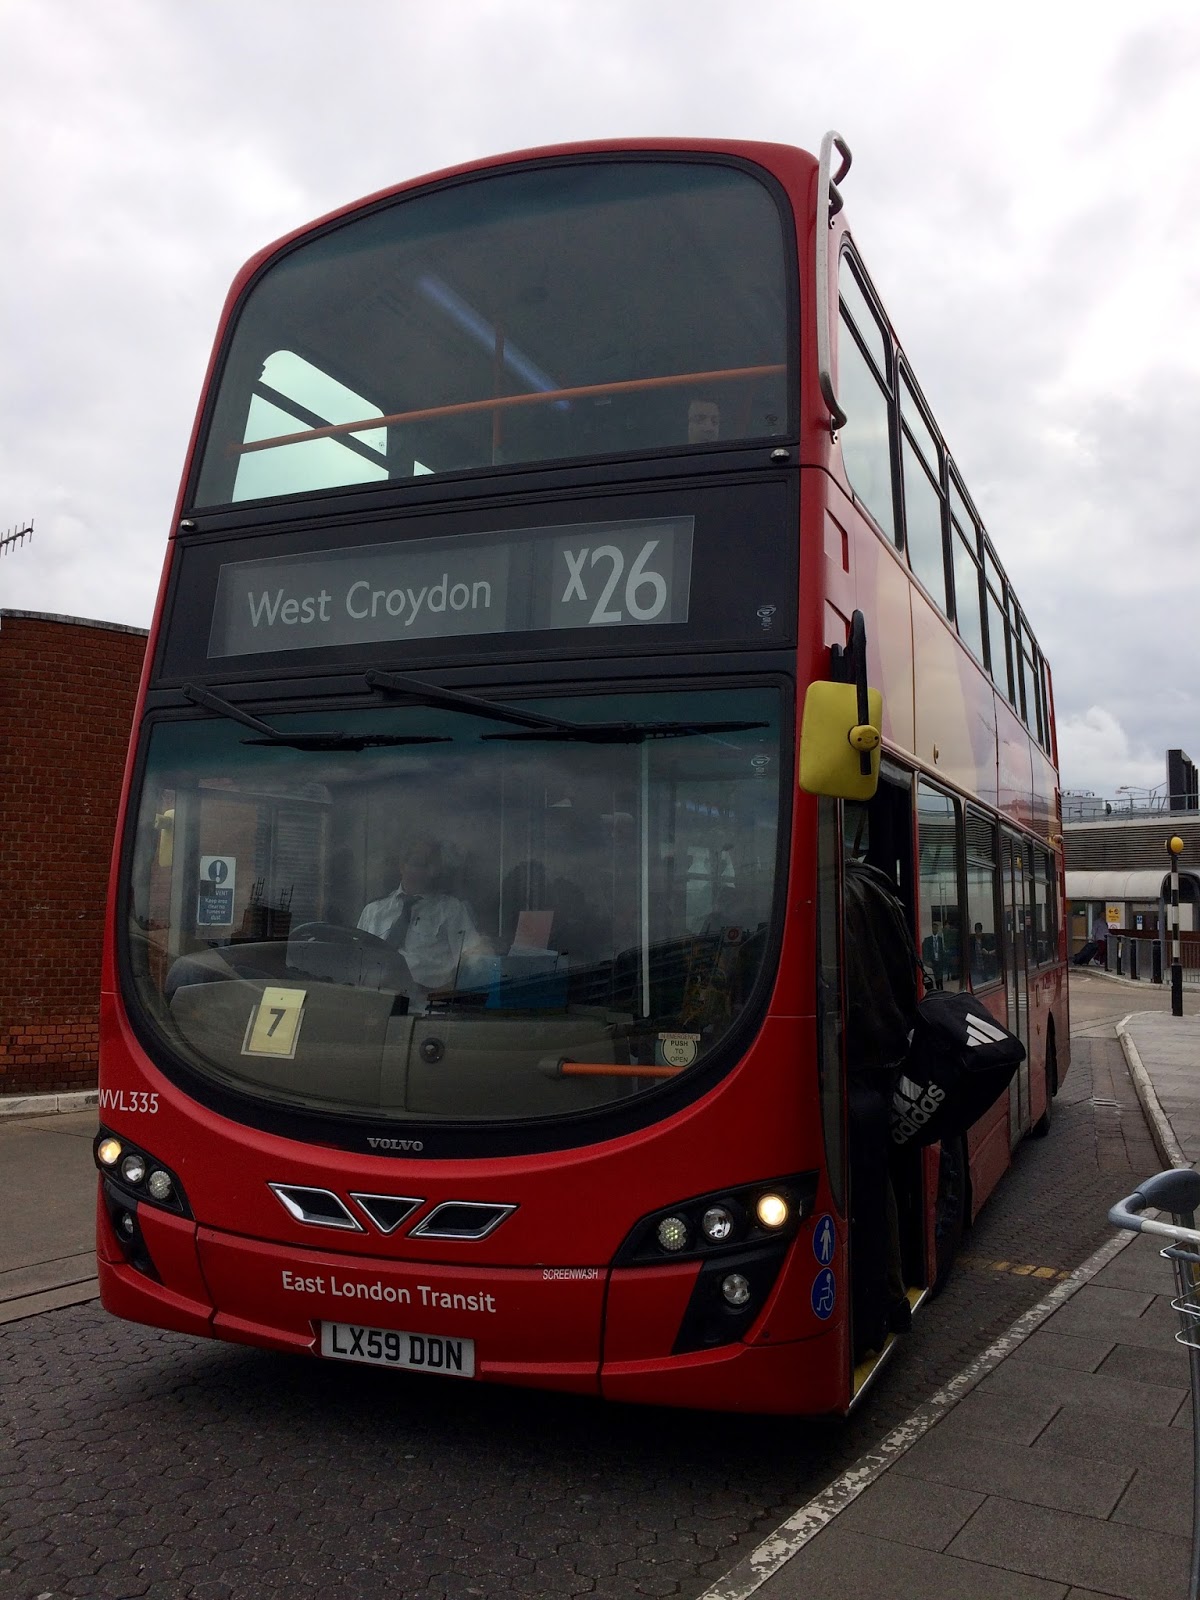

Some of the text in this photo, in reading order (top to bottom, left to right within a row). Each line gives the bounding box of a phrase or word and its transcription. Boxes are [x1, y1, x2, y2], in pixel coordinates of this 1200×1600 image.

[248, 574, 491, 627] West Croydon
[562, 540, 667, 624] X26
[267, 1008, 287, 1038] 7
[99, 1088, 159, 1114] WVL335
[892, 1084, 946, 1144] adidas
[367, 1137, 424, 1151] VOLVO
[282, 1271, 496, 1312] East London Transit
[542, 1268, 598, 1280] SCREENWASH
[332, 1324, 463, 1370] LX59 DDN
